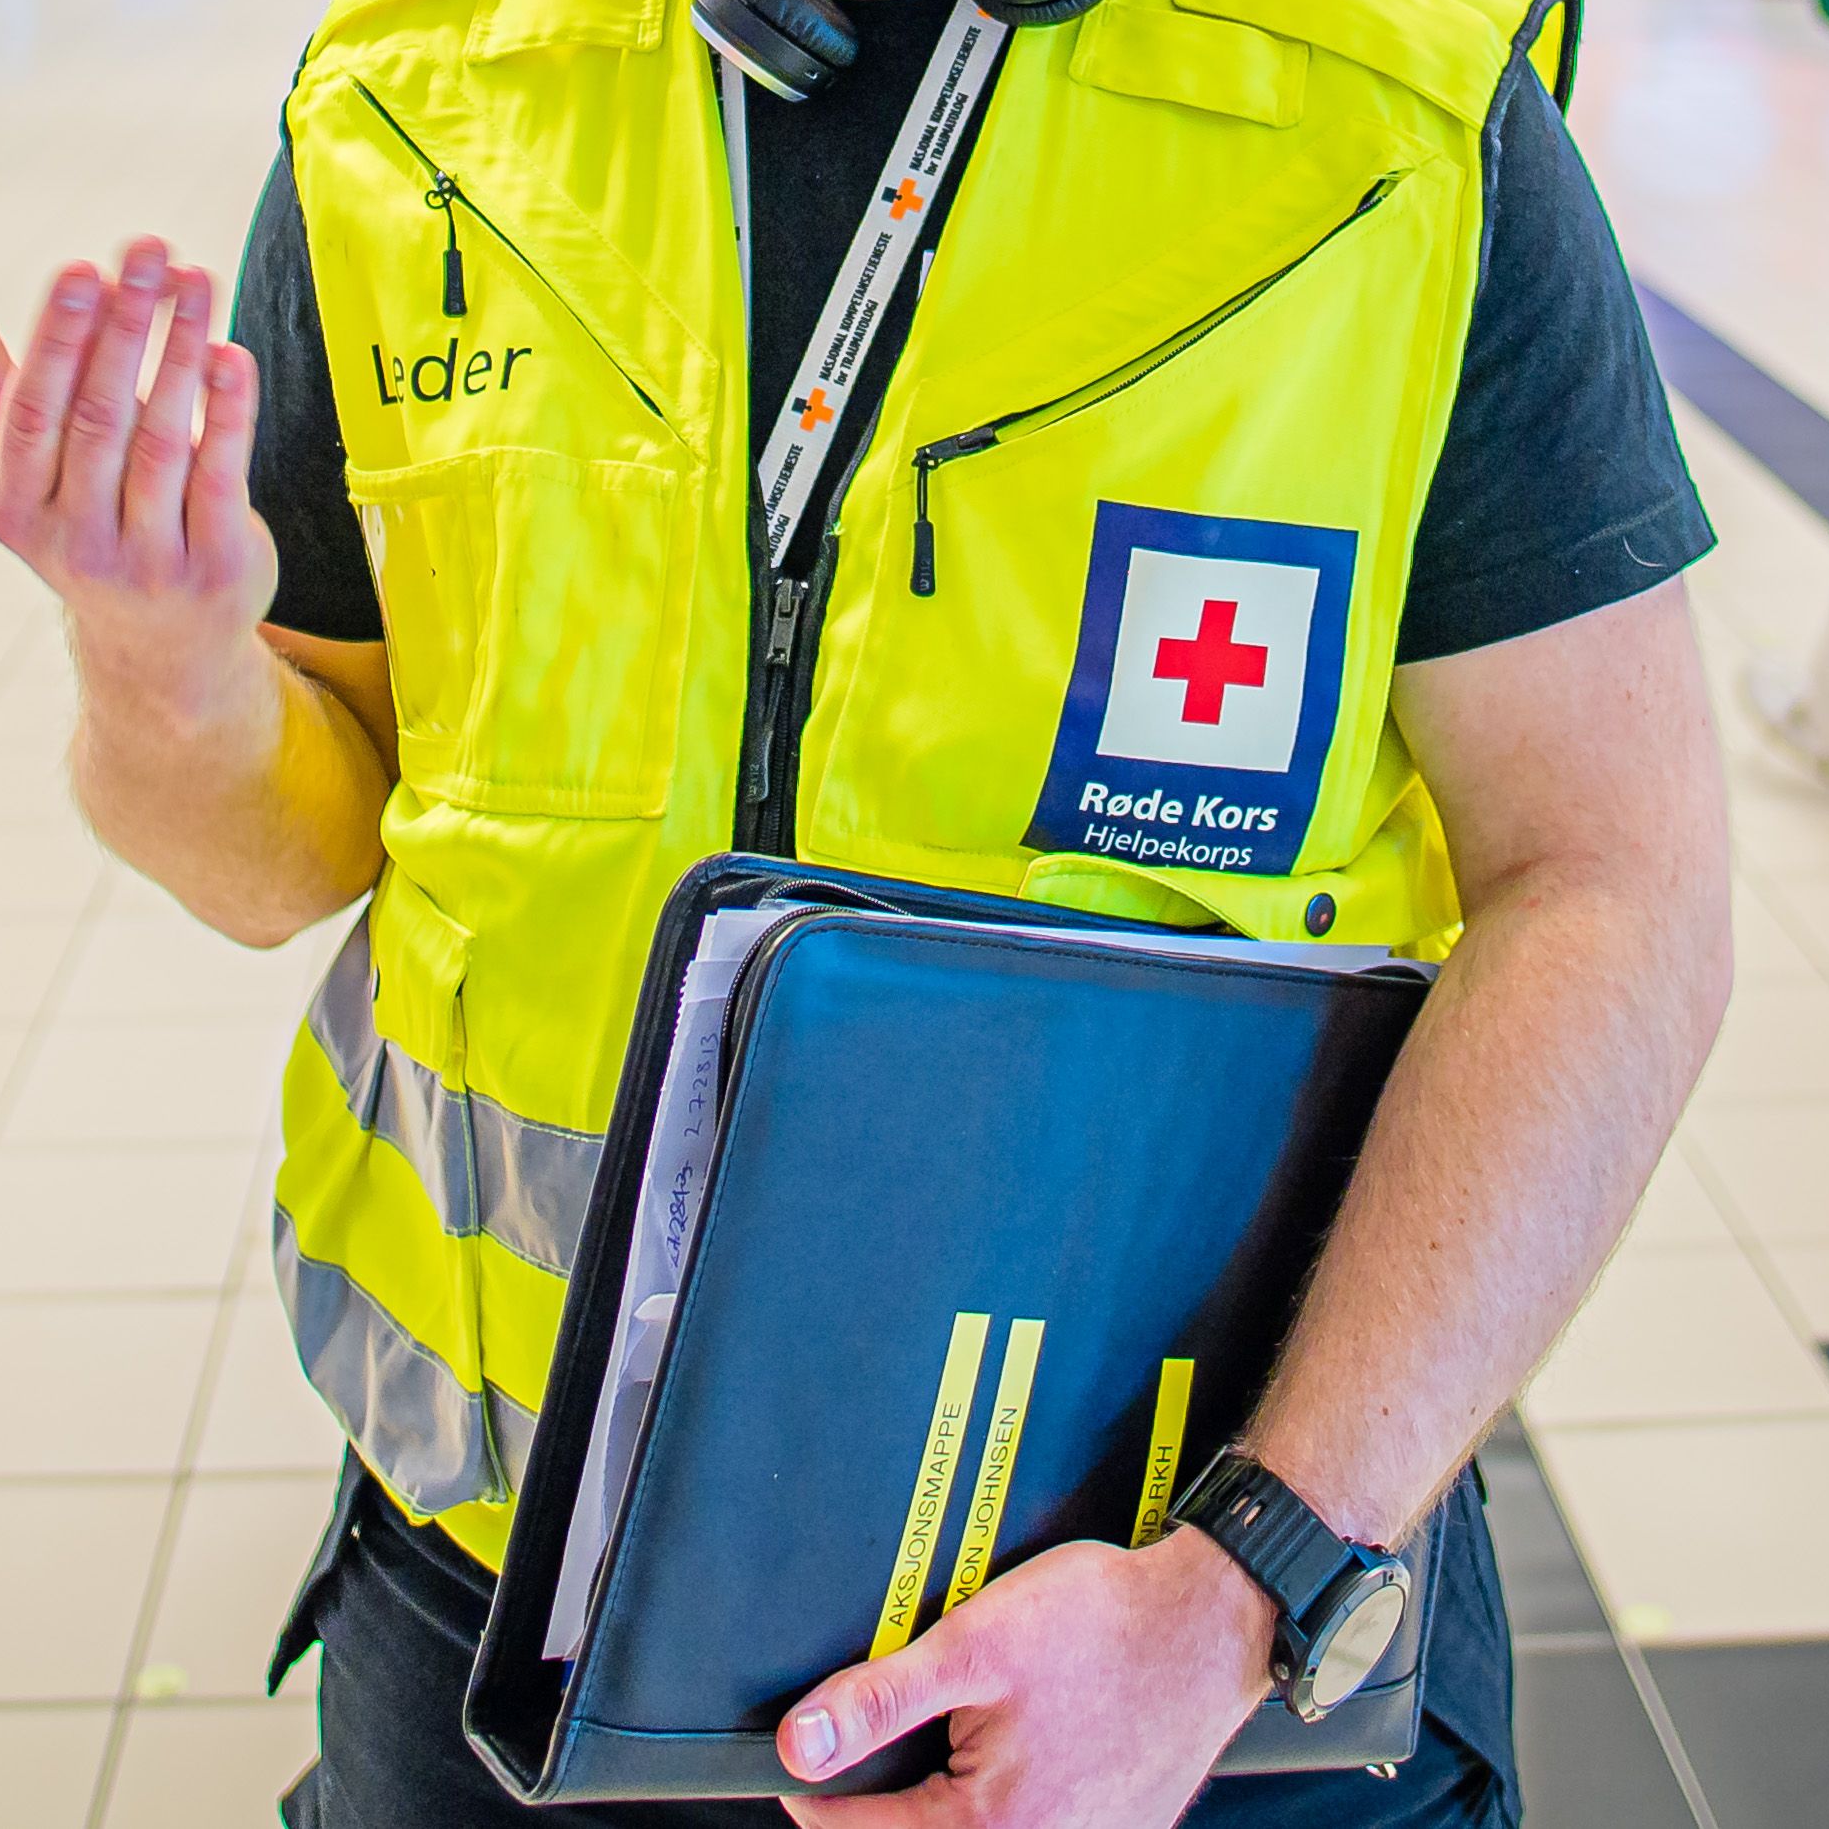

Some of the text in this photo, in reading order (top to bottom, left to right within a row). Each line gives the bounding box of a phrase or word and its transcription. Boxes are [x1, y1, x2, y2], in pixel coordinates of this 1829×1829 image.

[909, 25, 982, 171] NASJONAL KOMPETANSETJENESTE
[924, 92, 969, 176] for TRAUMATOLOGI
[818, 231, 893, 381] NASJONAL KOMPETANSETJENESTE
[833, 299, 879, 386] for TRAUMATOLOGI
[371, 338, 532, 406] Leder
[765, 443, 804, 521] ETANSETJENESTE
[768, 514, 791, 560] ATOLOGI
[1079, 782, 1279, 832] Røde Kors
[1083, 824, 1253, 870] Hjelpekorps
[888, 1401, 962, 1627] AKSJONSMAPPE
[952, 1407, 1018, 1608] MON JOHNSEN
[1137, 1445, 1174, 1548] ND RKH
